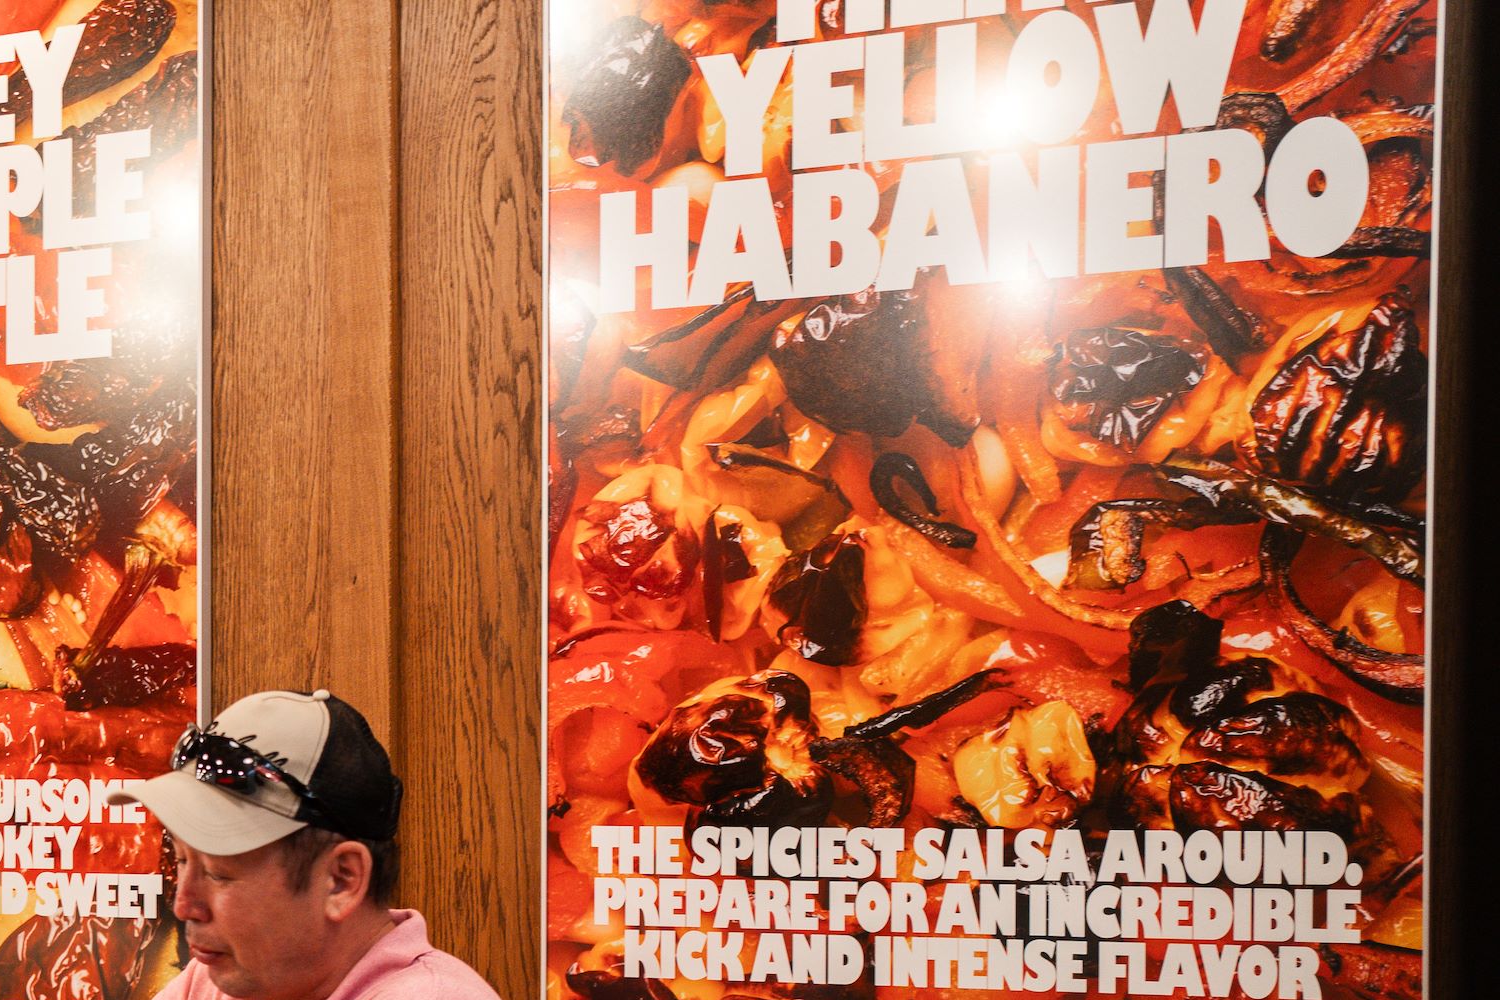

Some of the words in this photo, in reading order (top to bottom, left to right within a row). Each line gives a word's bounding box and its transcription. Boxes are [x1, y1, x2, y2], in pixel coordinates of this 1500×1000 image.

[697, 0, 1247, 176] YELLOW
[596, 116, 1371, 314] HABANERO
[591, 826, 684, 876] THE
[691, 826, 905, 880] SPICIEST
[912, 828, 1094, 883] SALSA
[1100, 829, 1363, 887] AROUND.
[35, 872, 163, 919] SWEET
[594, 877, 820, 932] PREPARE
[828, 881, 931, 935] FOR
[934, 882, 1021, 936] AN
[1028, 884, 1364, 945] INCREDIBLE
[624, 929, 748, 982] KICK
[745, 932, 862, 986] AND
[874, 935, 1088, 993] INTENSE
[1098, 941, 1324, 1000] FLAVOR
